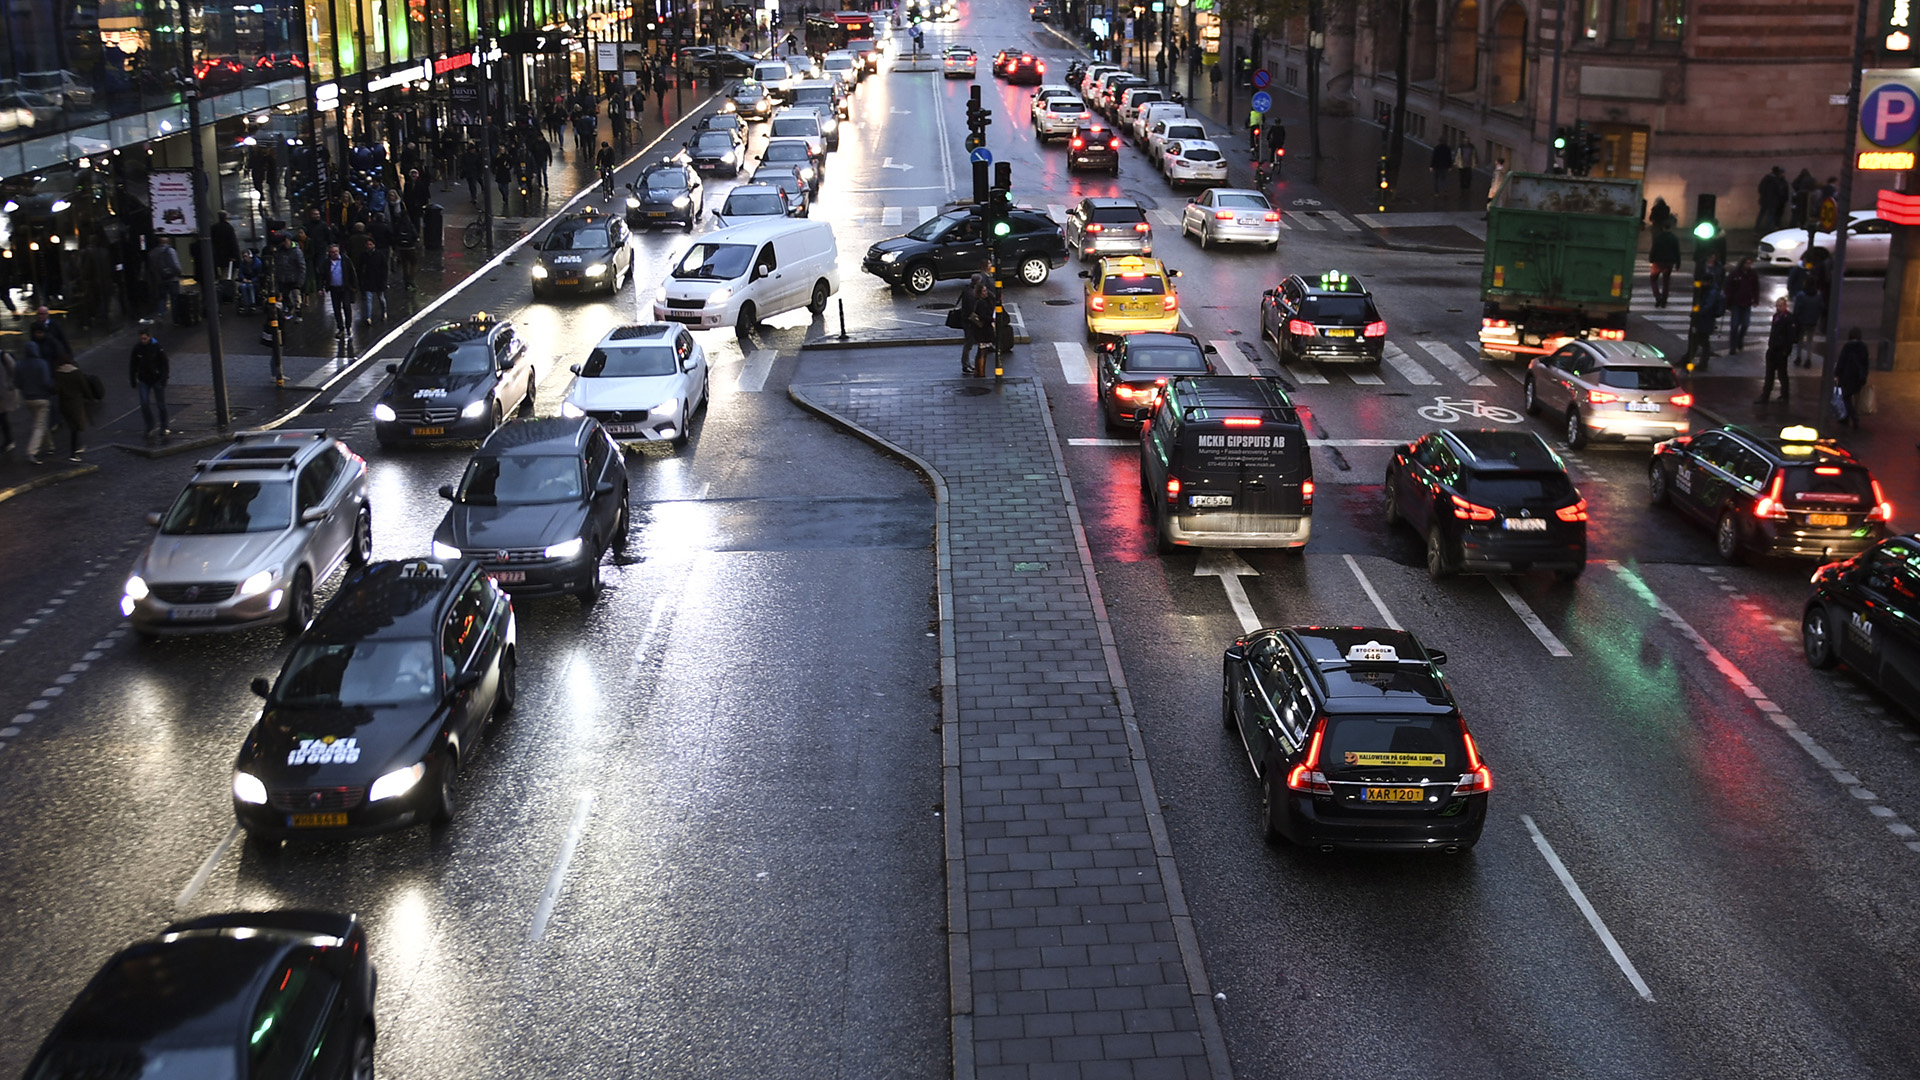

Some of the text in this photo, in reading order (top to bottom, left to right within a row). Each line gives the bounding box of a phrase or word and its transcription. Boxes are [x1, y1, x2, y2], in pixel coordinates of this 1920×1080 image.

[1874, 91, 1915, 141] P
[1198, 435, 1285, 448] MCKH GIPSPUTS AB
[1213, 496, 1229, 505] 534
[299, 738, 357, 750] TAXI
[1391, 753, 1398, 761] PÅ
[1368, 789, 1390, 799] XAR
[1393, 789, 1414, 800] 120
